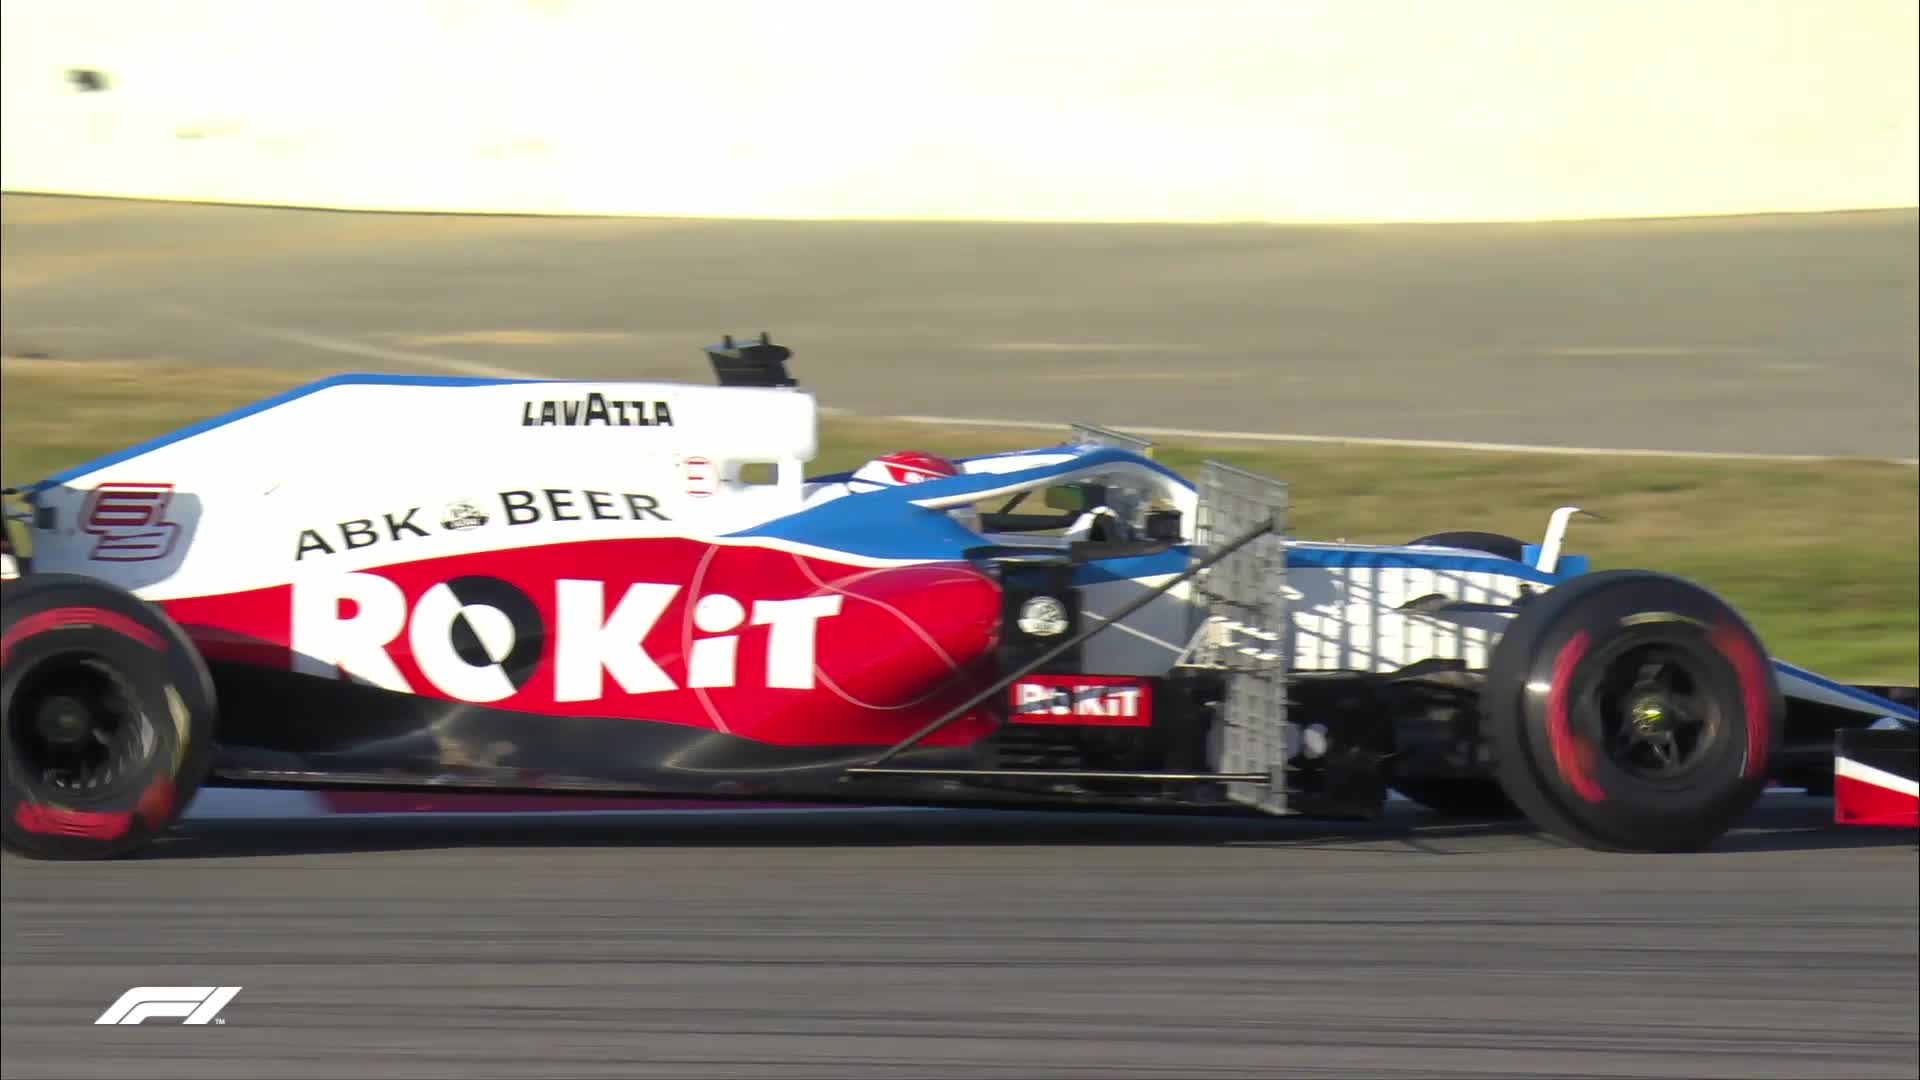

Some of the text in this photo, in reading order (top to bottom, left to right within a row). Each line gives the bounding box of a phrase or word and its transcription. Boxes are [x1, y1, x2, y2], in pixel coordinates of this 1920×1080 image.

[522, 393, 673, 426] LAVAZZA
[295, 488, 671, 561] ABK BEER
